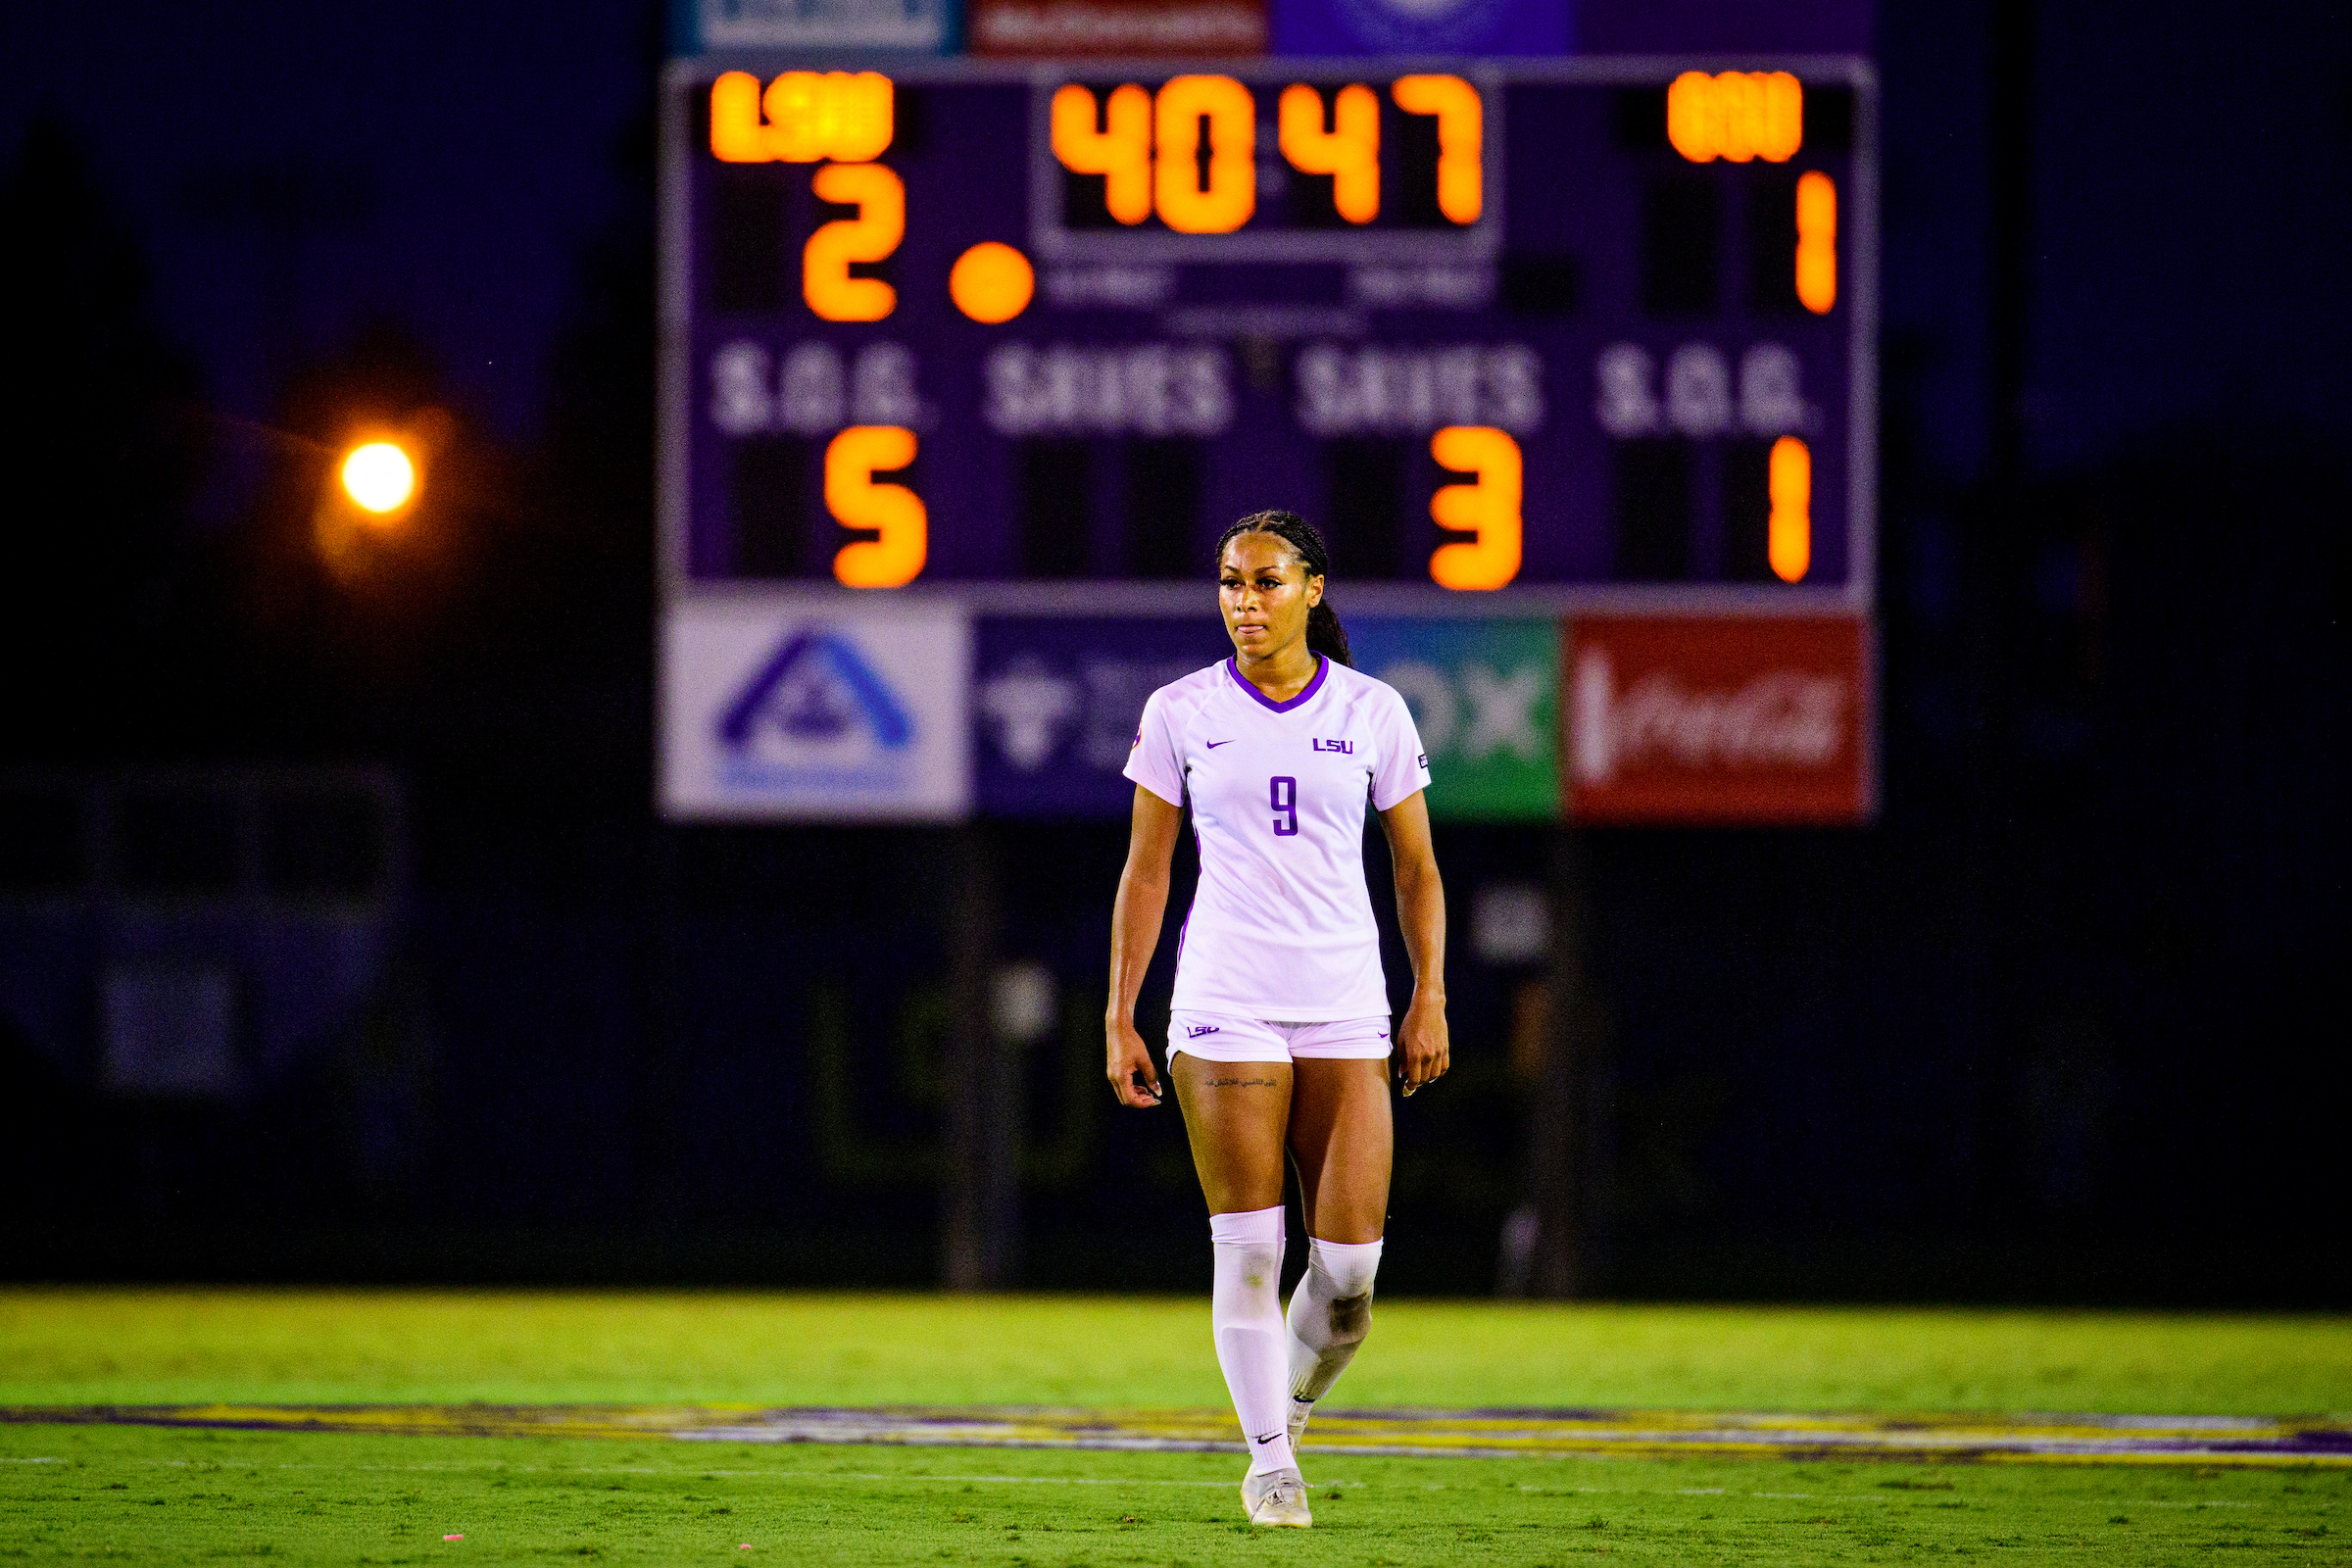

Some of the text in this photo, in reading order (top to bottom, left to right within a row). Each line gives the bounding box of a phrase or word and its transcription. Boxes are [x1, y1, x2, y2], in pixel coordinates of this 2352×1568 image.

[710, 72, 894, 163] LSU
[803, 163, 905, 321] 2
[1795, 171, 1837, 314] 1
[825, 425, 927, 589] 5
[1431, 426, 1522, 591] 3
[1769, 435, 1811, 583] 1
[1270, 775, 1298, 837] 9
[1312, 737, 1353, 755] LSU
[1186, 1025, 1221, 1039] LSU
